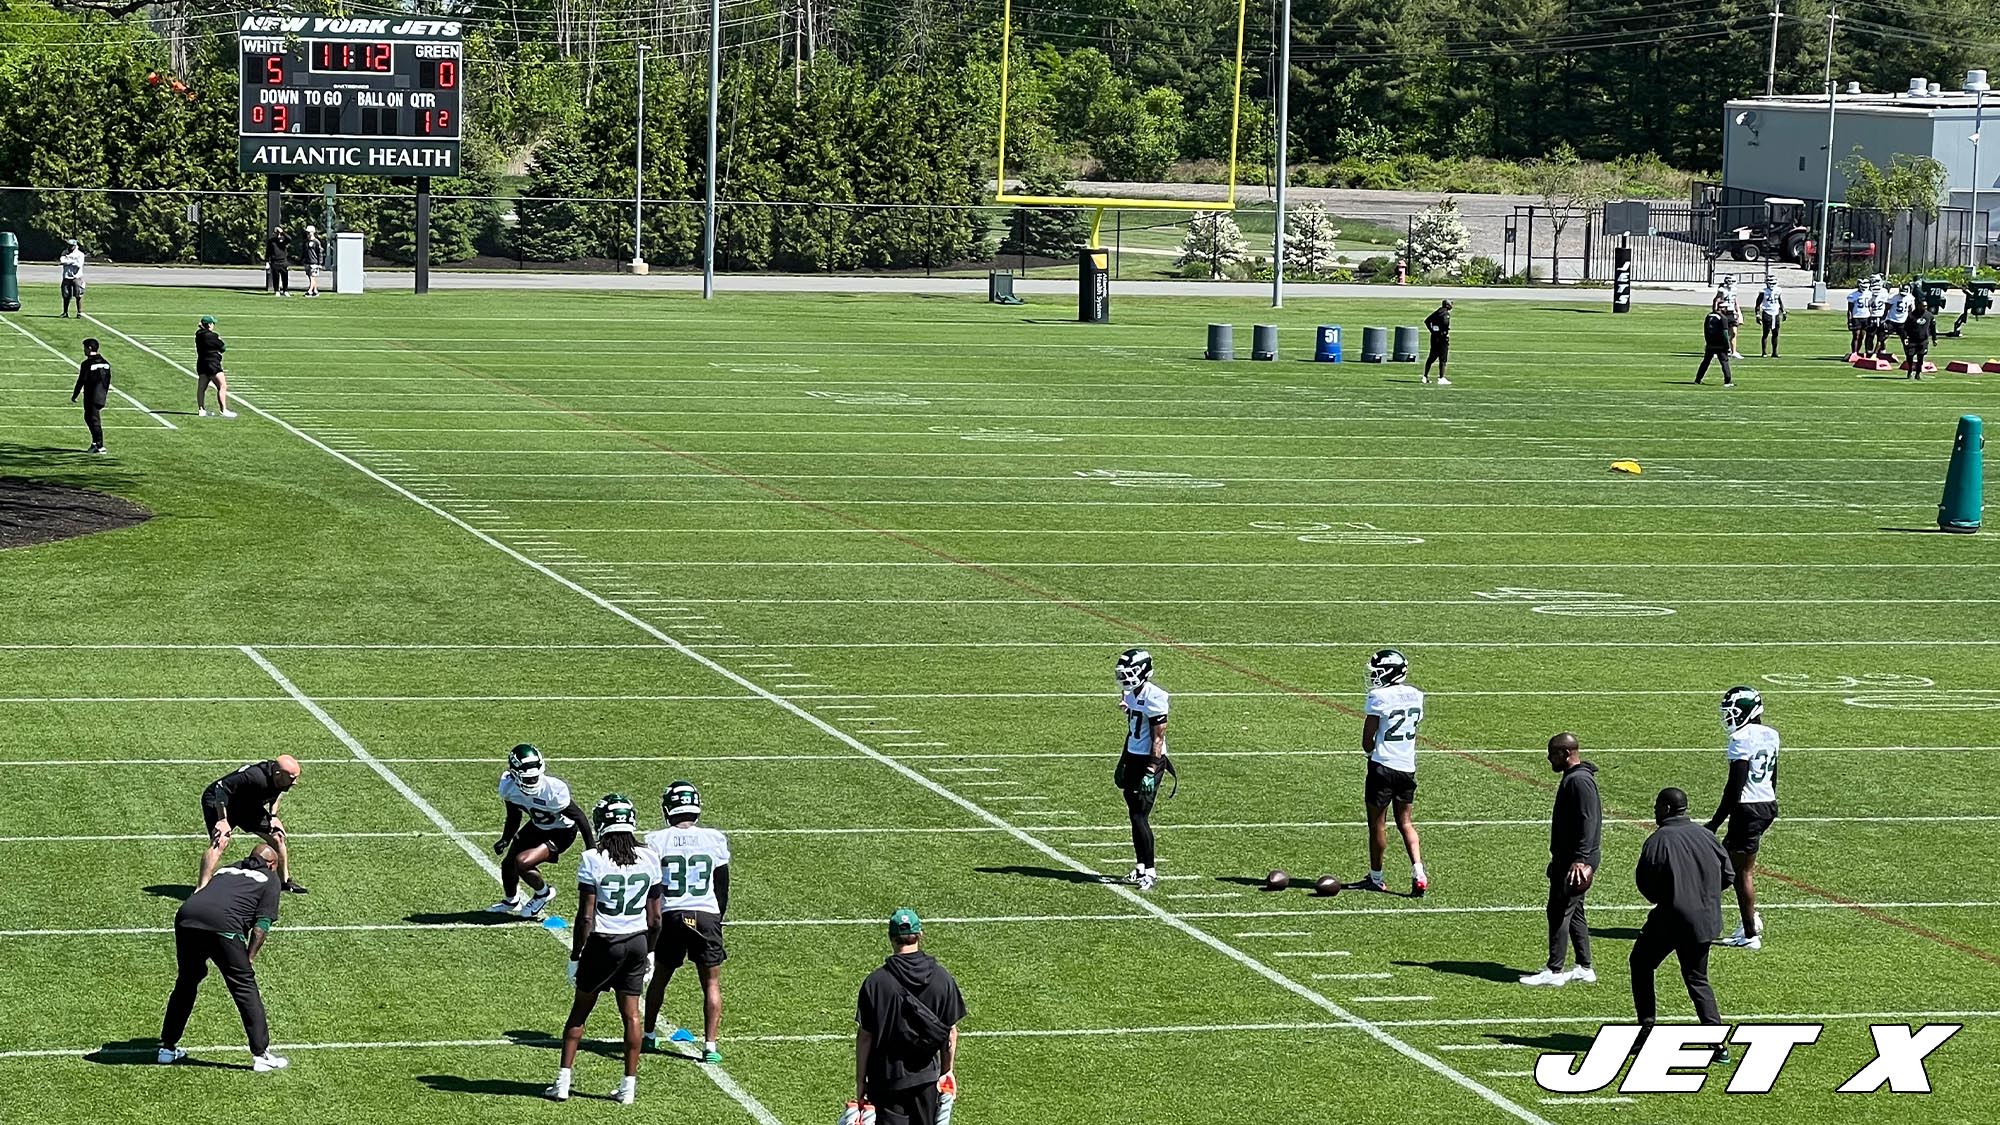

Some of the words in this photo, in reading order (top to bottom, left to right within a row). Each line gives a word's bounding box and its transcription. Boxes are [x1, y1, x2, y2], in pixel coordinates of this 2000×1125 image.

[241, 16, 310, 32] NEW
[313, 17, 391, 34] YORK
[392, 20, 462, 36] JETS
[243, 39, 288, 53] WHITE
[324, 43, 390, 70] 11:12
[415, 45, 459, 58] GREEN
[267, 57, 282, 84] 5
[439, 61, 455, 88] 0
[260, 89, 299, 105] DOWN
[303, 90, 320, 105] TO
[324, 91, 342, 106] GO
[357, 92, 385, 107] BALL
[386, 92, 403, 107] ON
[410, 92, 436, 108] QTR
[253, 106, 263, 122] 0
[273, 105, 286, 131] 3
[424, 109, 431, 133] 1
[438, 110, 449, 127] 2
[252, 145, 361, 165] ATLANTIC
[369, 148, 451, 167] HEALTH
[1615, 261, 1631, 304] JETS
[1324, 329, 1338, 343] 51
[1470, 586, 1677, 617] 40
[1384, 707, 1421, 742] 23
[616, 814, 627, 823] 32
[661, 854, 713, 898] 33
[597, 872, 651, 916] 32
